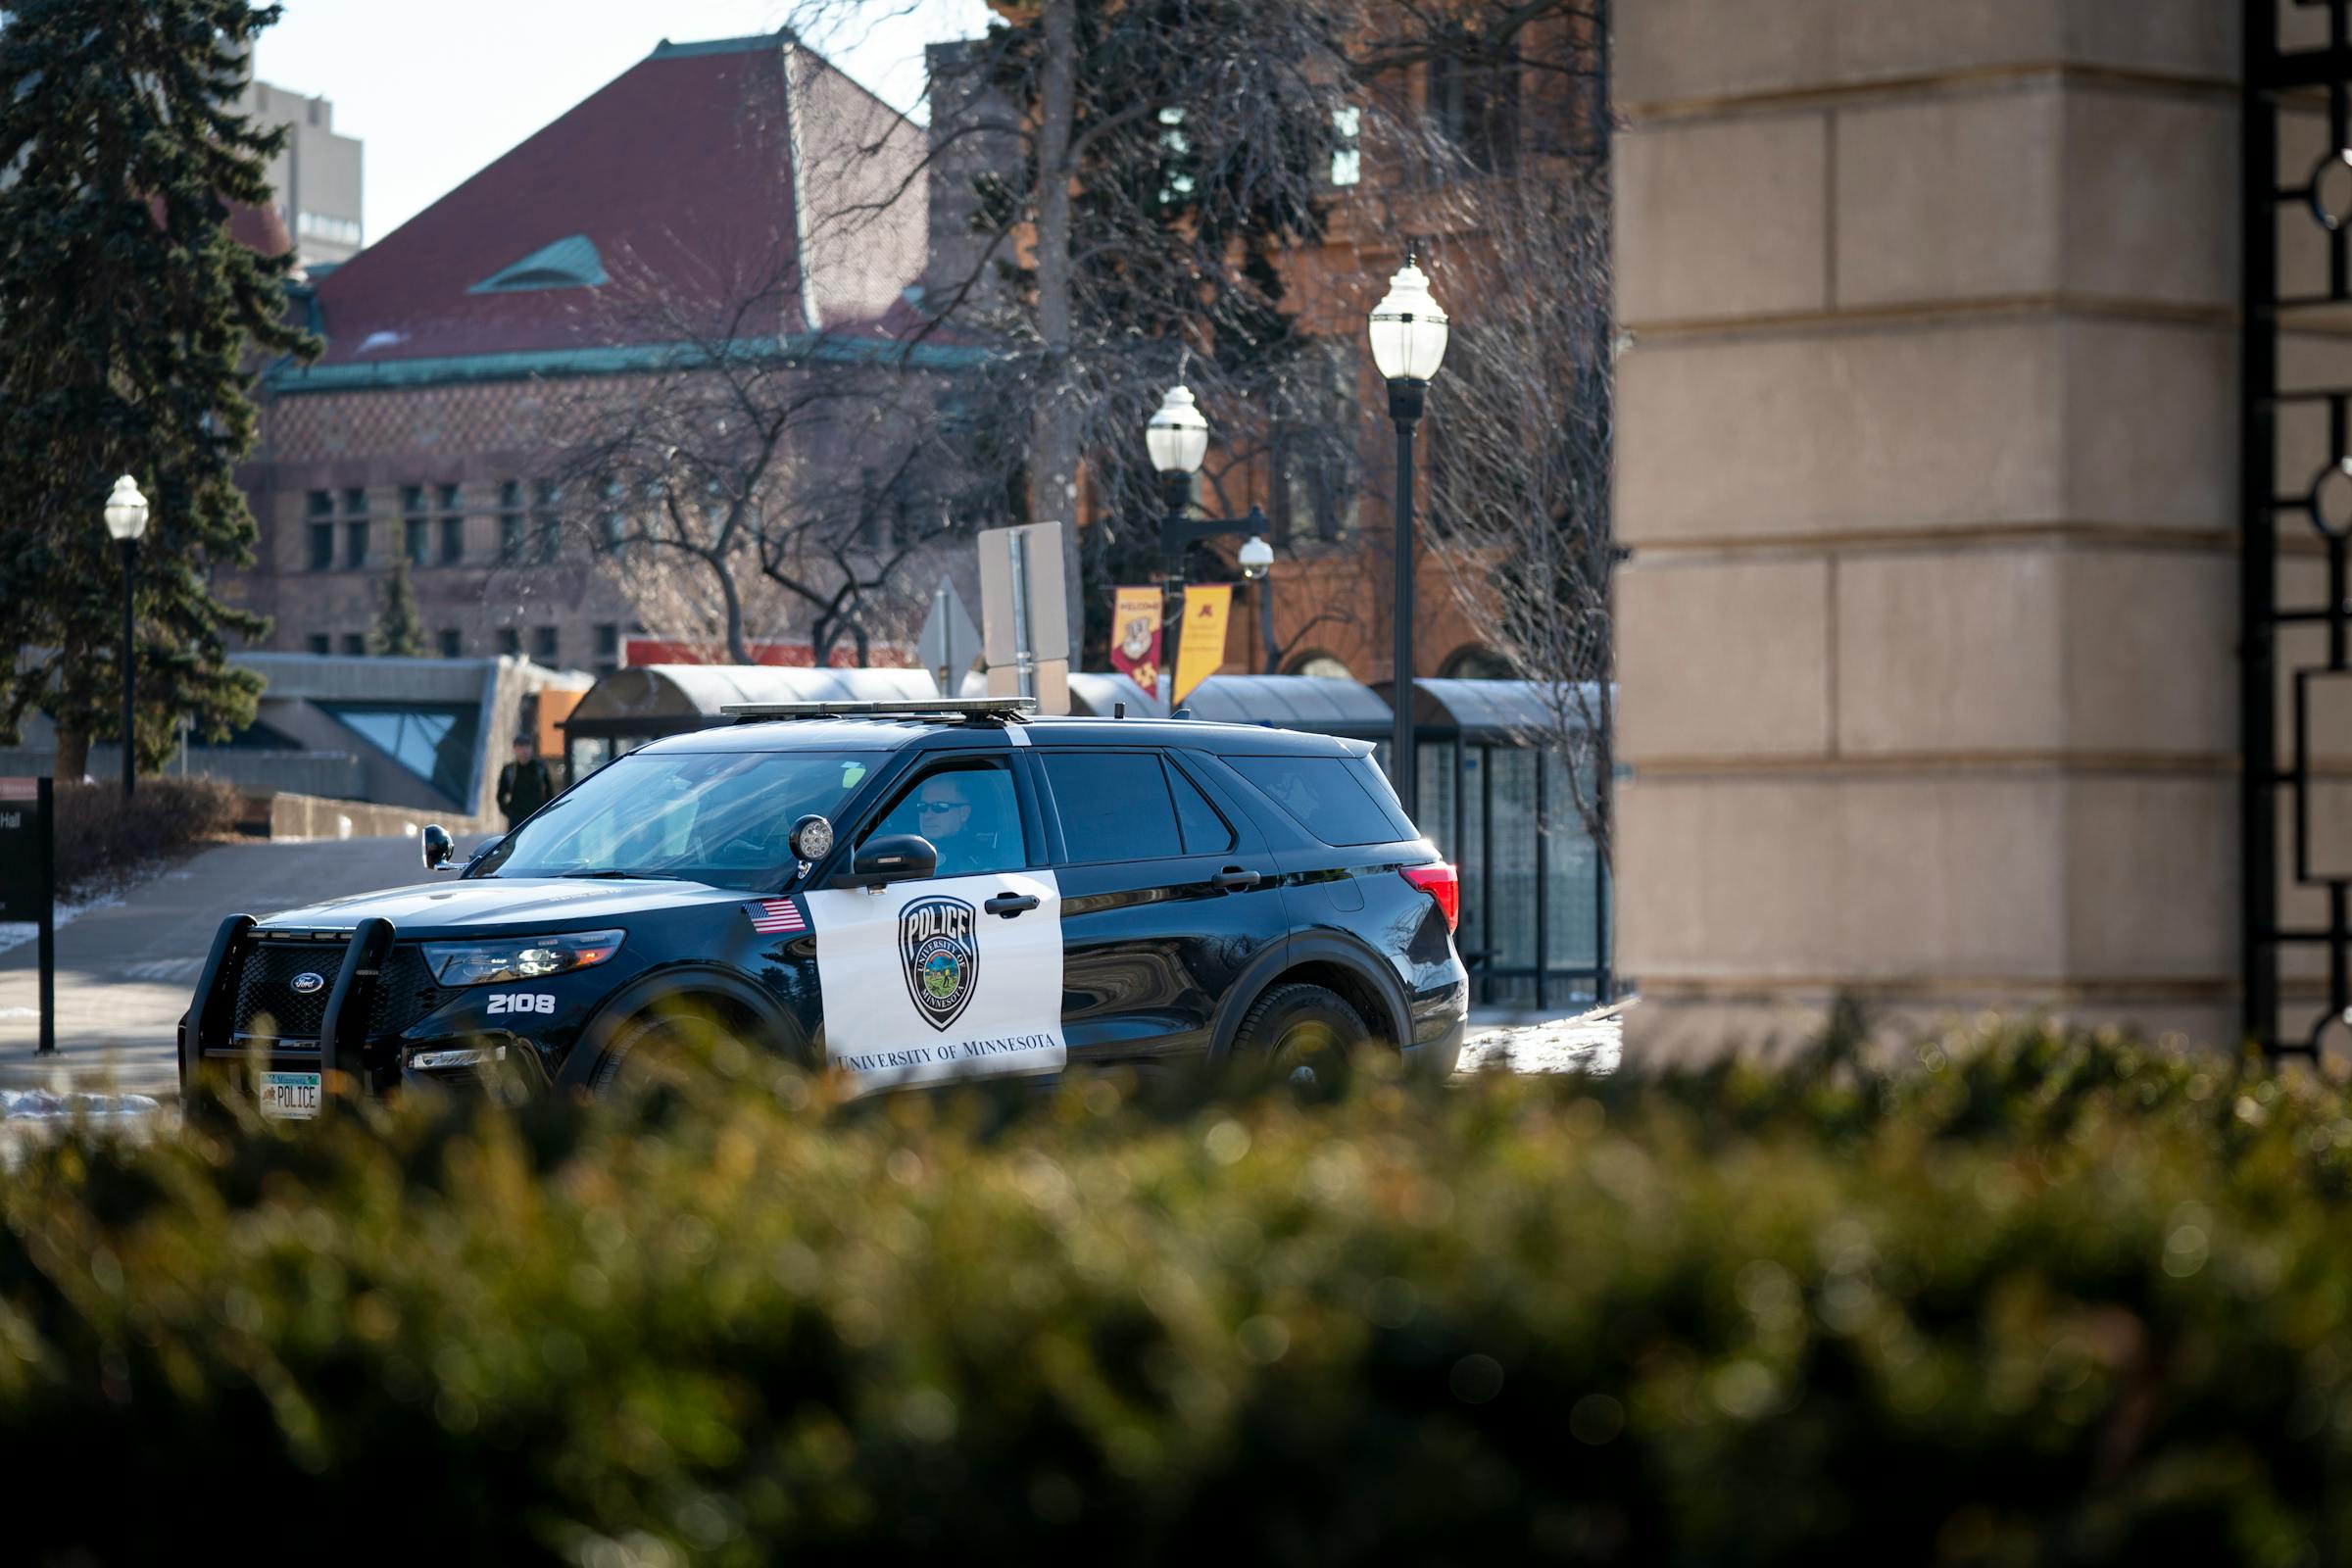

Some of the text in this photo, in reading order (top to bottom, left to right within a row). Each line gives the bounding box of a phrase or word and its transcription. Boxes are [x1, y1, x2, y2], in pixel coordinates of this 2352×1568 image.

[1121, 602, 1160, 612] WELCOME
[0, 811, 21, 828] Hall
[907, 905, 972, 961] POLICE
[917, 940, 966, 972] UNIVERSITY OF
[295, 976, 316, 989] Ford
[486, 993, 556, 1014] 2108
[921, 985, 965, 1008] MINNESOTA
[837, 1033, 1055, 1073] UNIVERSITY OF MINNESOTA
[277, 1085, 316, 1108] POLICE
